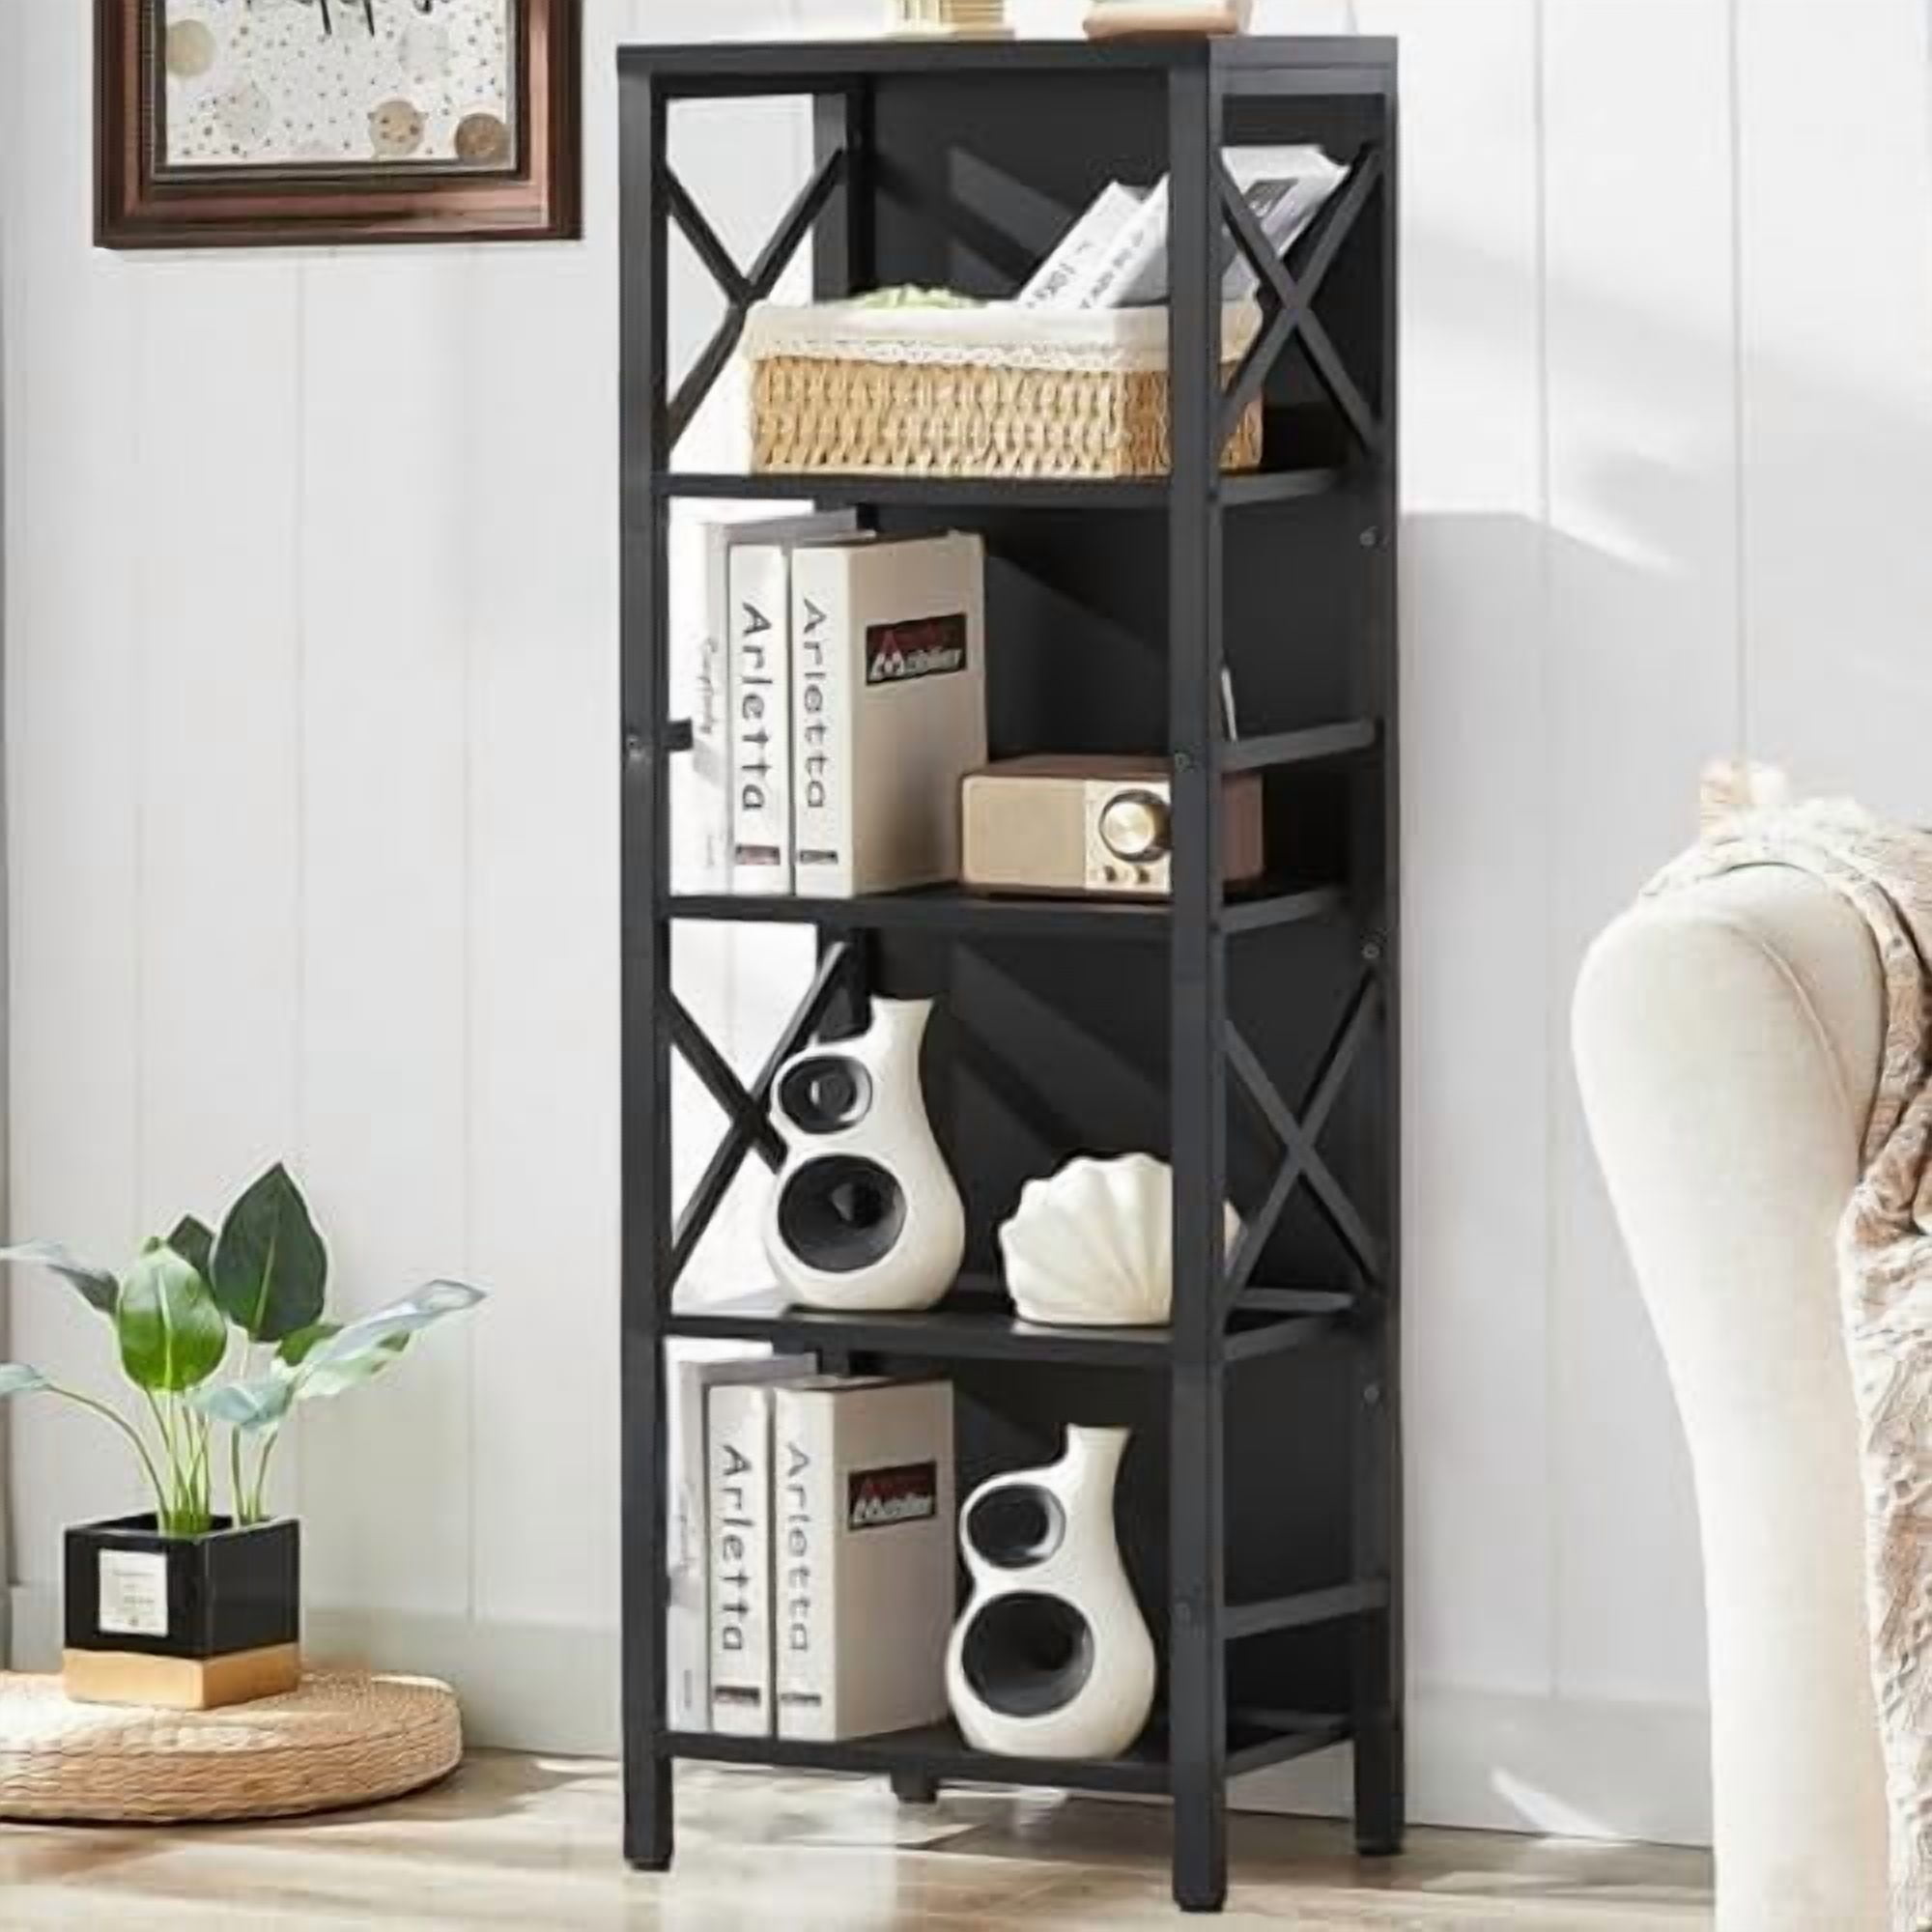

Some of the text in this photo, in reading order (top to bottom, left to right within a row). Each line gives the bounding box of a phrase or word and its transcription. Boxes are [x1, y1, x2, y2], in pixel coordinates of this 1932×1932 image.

[742, 602, 772, 810] Arletta
[803, 598, 827, 808] Arletta
[722, 1444, 753, 1651] Arletta
[786, 1442, 810, 1652] Arletta
